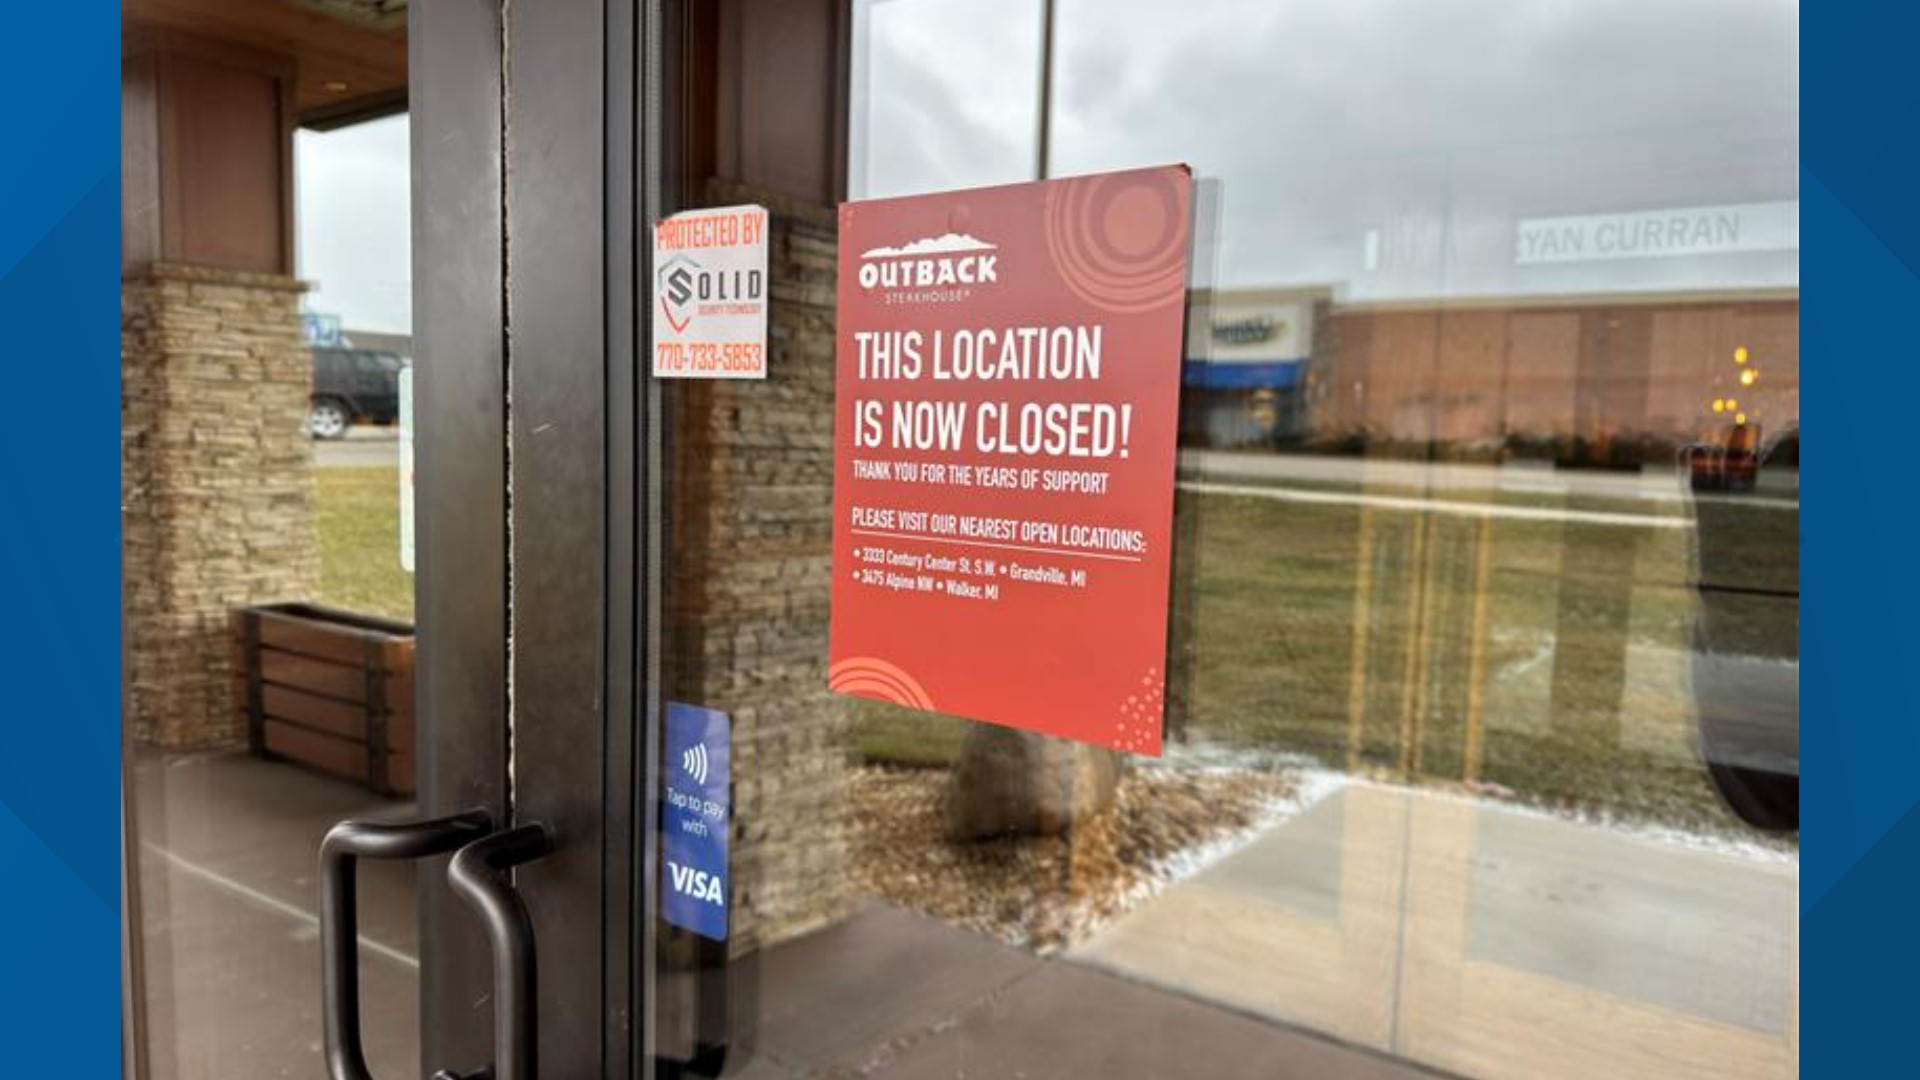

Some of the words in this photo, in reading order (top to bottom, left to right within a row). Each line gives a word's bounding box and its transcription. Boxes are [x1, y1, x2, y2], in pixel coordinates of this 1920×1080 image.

[656, 214, 738, 250] PROTECTED
[743, 212, 763, 245] BY
[1595, 212, 1741, 254] CURRAN
[668, 267, 762, 308] SOLID
[859, 255, 997, 289] OUTBACK
[657, 342, 762, 370] 770-733-5853
[855, 331, 923, 380] THIS
[934, 325, 1102, 380] LOCATION
[854, 400, 883, 448] IS
[892, 401, 967, 450] NOW
[976, 403, 1133, 458] CLOSED!
[853, 460, 892, 480] THANK
[894, 461, 919, 482] YOU
[921, 463, 946, 484] FOR
[948, 465, 972, 486] THE
[974, 466, 1018, 489] YEARS
[1021, 468, 1040, 490] OF
[1042, 469, 1110, 494] SUPPORT
[852, 506, 896, 529] PLEASE
[898, 510, 929, 532] VISIT
[930, 513, 957, 535] OUR
[959, 515, 1018, 541] NEAREST
[1021, 520, 1059, 544] OPEN
[1061, 524, 1147, 553] LOCATIONS:
[862, 569, 885, 586] 3475
[886, 573, 915, 591] Alpine
[985, 583, 999, 600] MI
[886, 549, 923, 572] Century
[925, 553, 957, 573] Center
[1071, 569, 1086, 587] MI
[667, 787, 687, 810] Tap
[689, 795, 701, 812] to
[703, 800, 726, 820] pay
[682, 819, 708, 838] with
[667, 860, 724, 906] VISA
